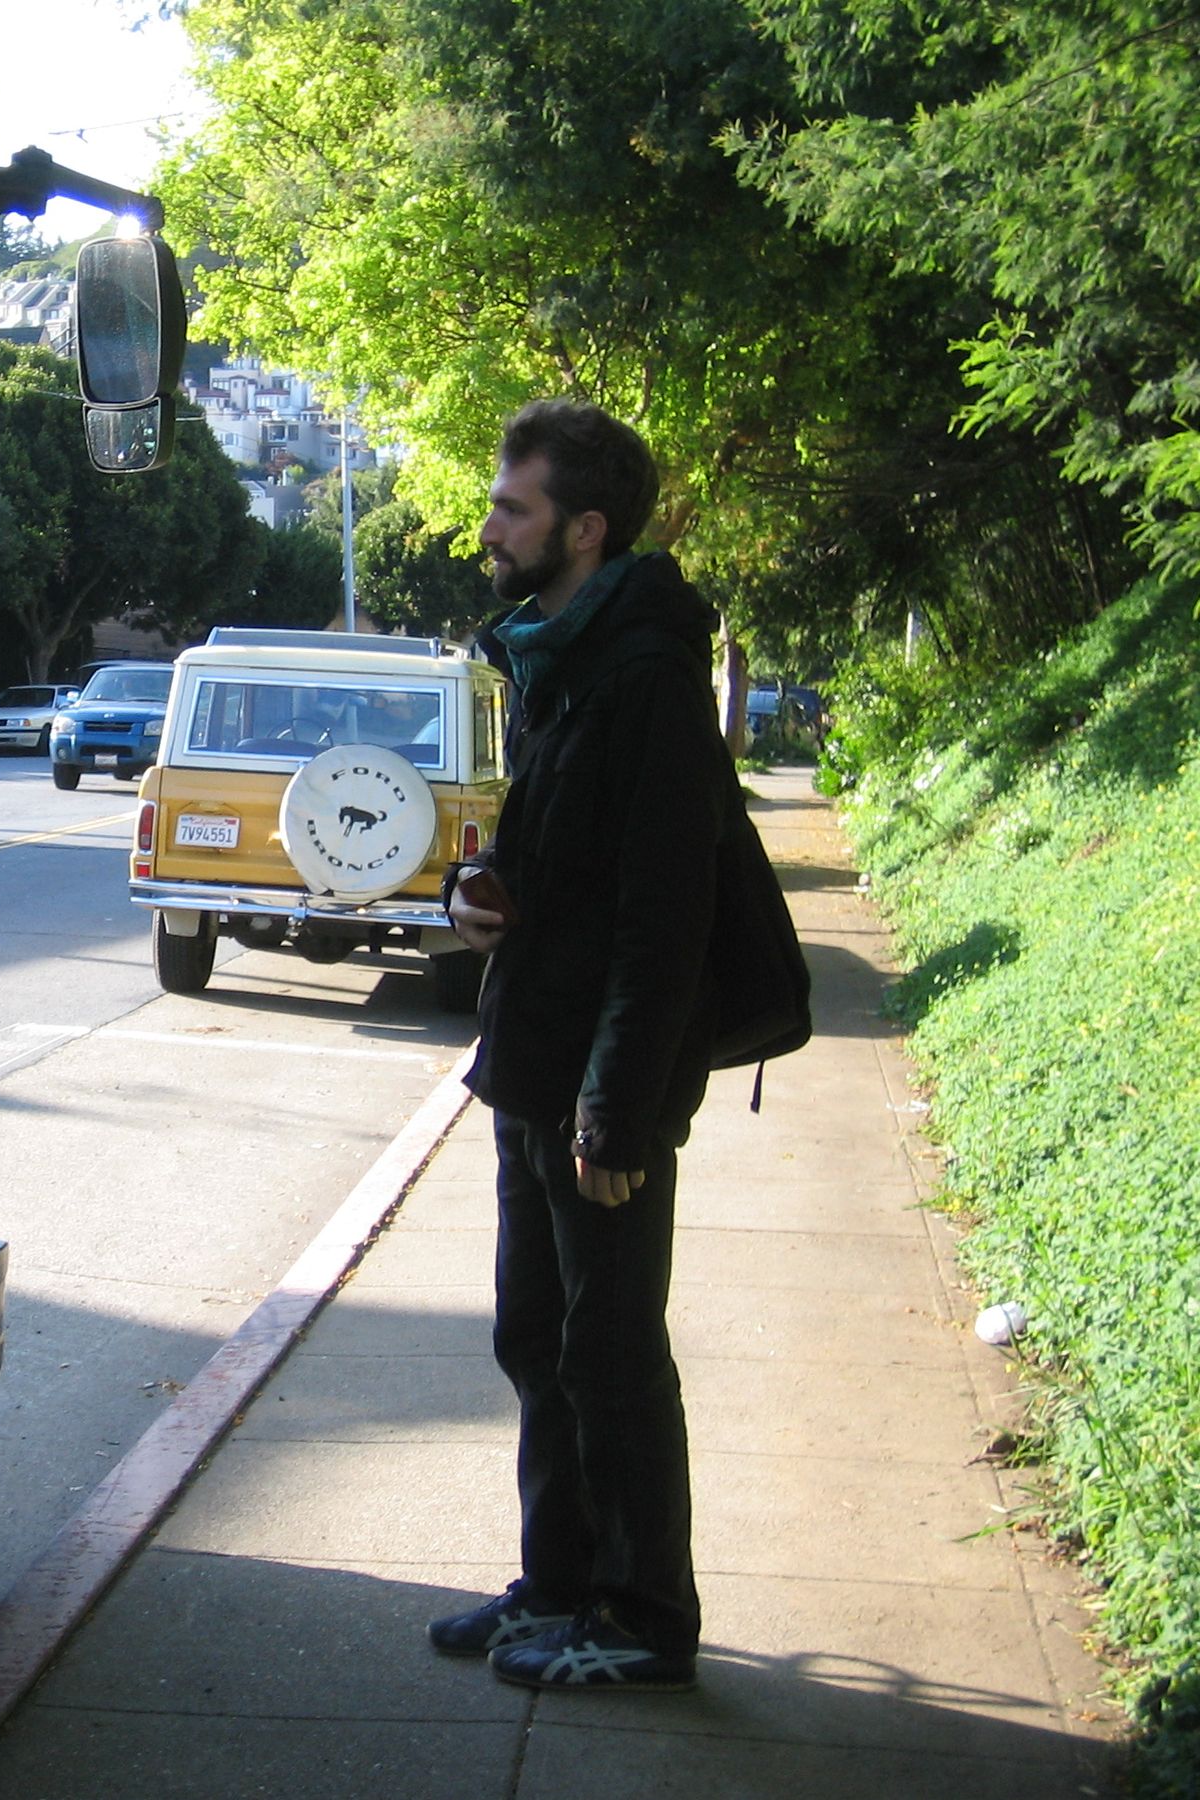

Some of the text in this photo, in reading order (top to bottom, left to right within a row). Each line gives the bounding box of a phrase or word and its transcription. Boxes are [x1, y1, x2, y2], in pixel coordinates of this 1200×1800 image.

[330, 766, 406, 804] FORD
[181, 825, 233, 843] 7V94551
[307, 818, 401, 872] BRONCO
